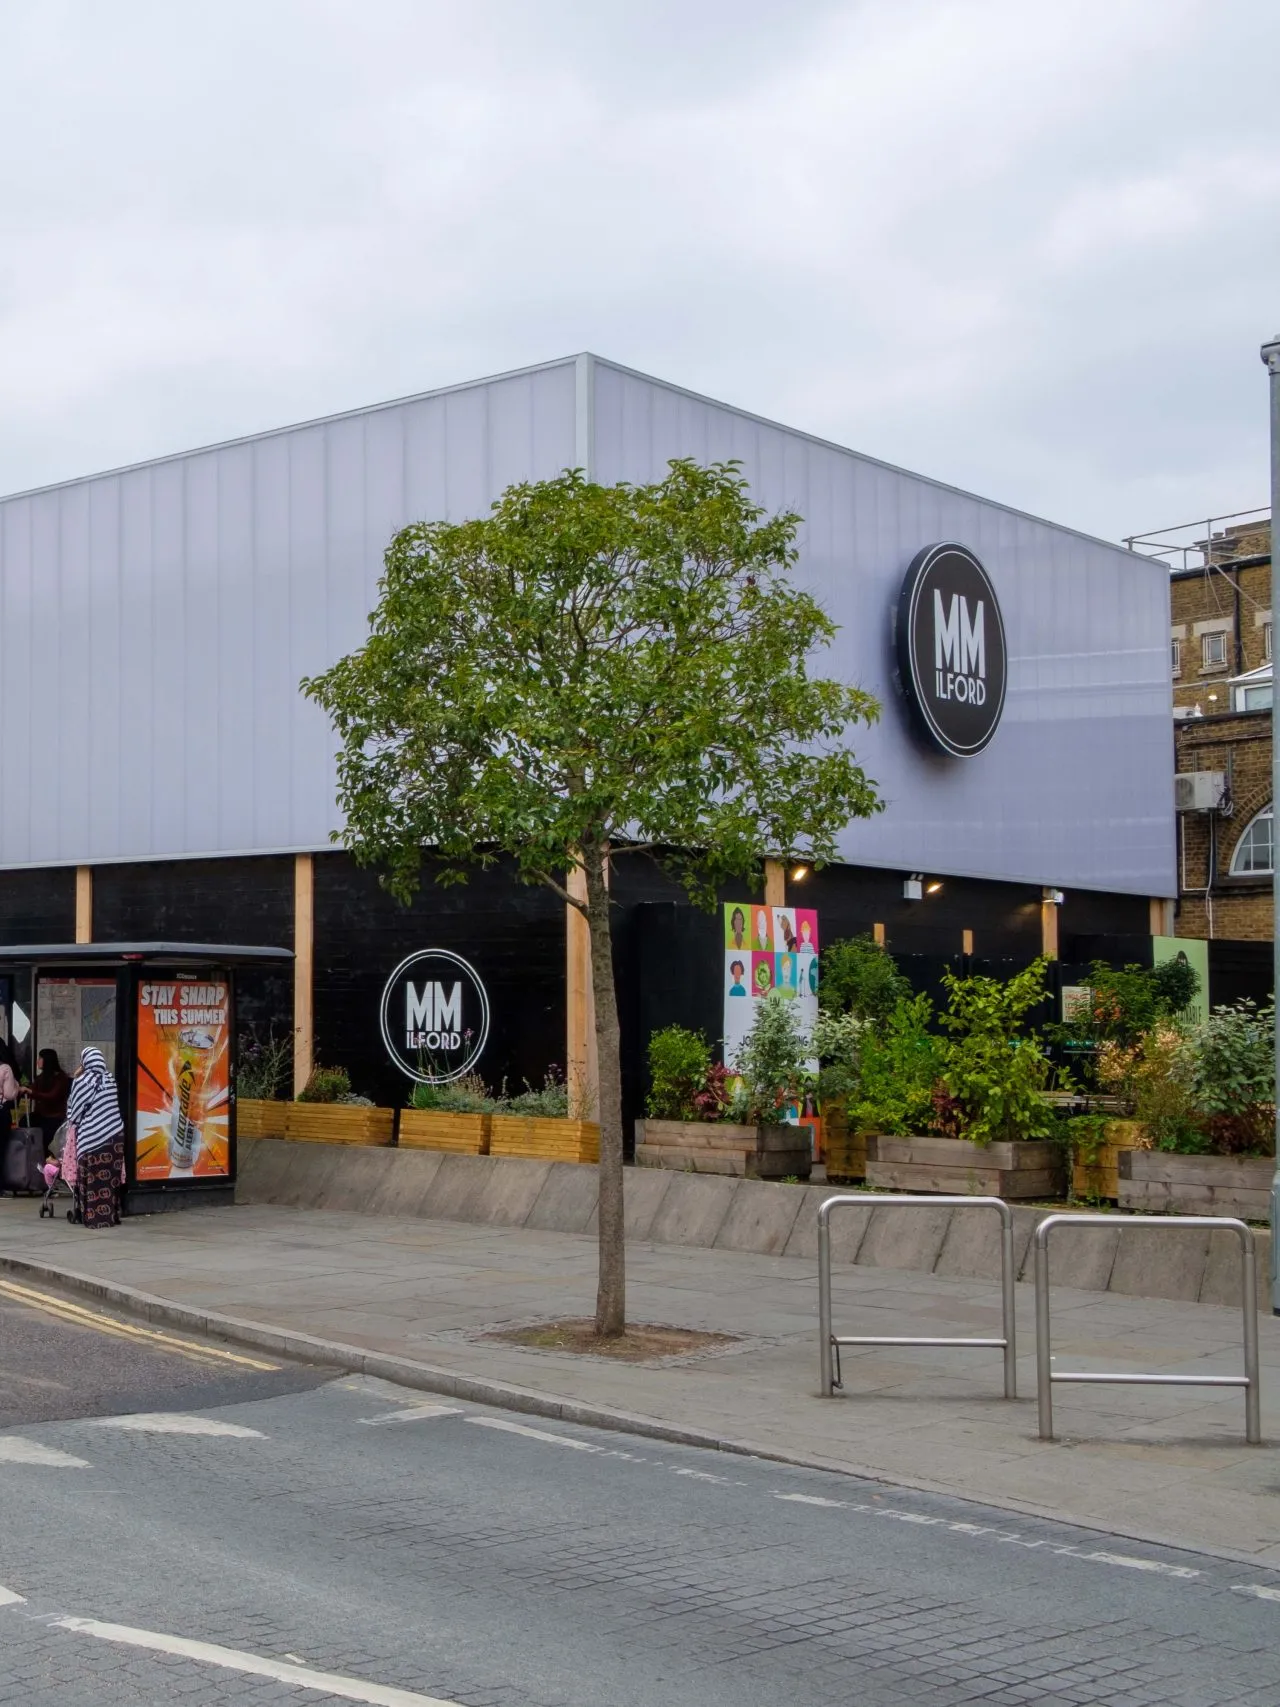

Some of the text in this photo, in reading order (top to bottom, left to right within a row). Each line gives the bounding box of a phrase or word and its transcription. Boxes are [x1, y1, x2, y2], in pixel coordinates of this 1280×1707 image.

[933, 588, 985, 678] MM
[935, 670, 986, 706] ILFORD
[141, 985, 225, 1006] STAY SHARP
[406, 981, 461, 1032] MM
[154, 1008, 225, 1025] THIS SUMMER
[406, 1031, 461, 1049] ILFORD
[174, 1078, 192, 1147] Lucozade
[185, 1120, 195, 1151] ALERT
